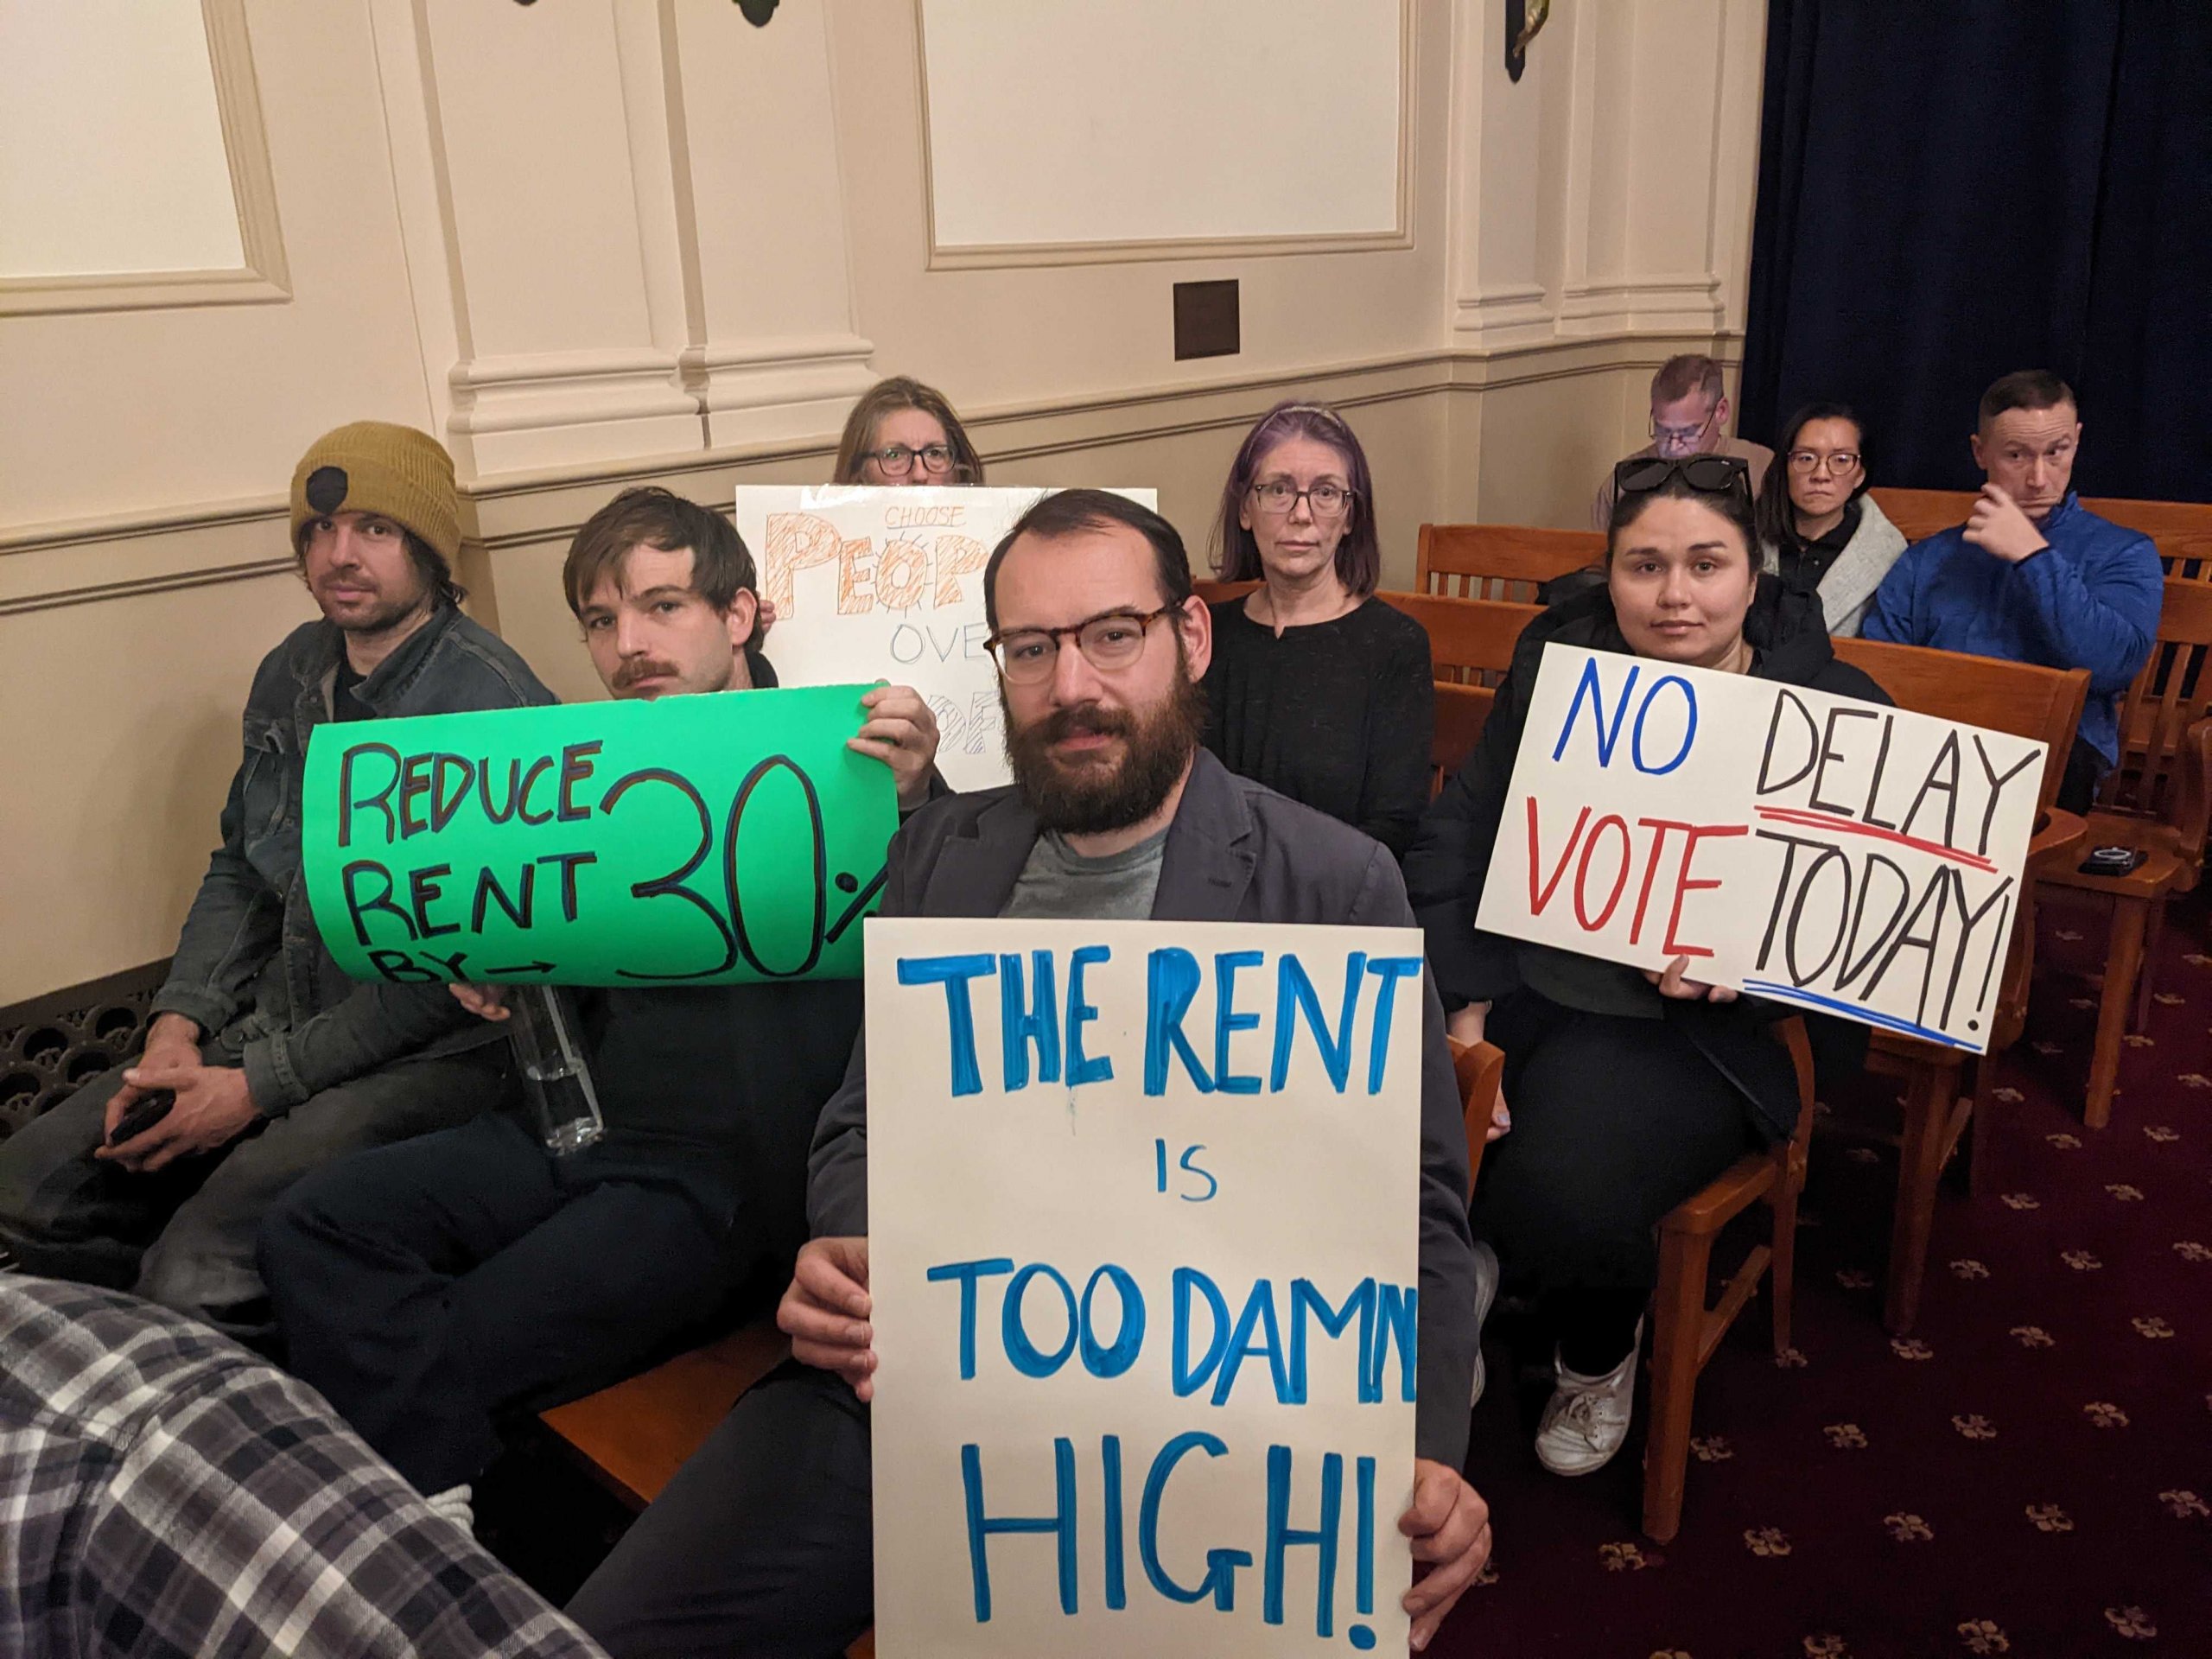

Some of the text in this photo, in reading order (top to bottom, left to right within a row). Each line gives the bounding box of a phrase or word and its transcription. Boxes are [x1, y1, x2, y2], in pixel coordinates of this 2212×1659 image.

[766, 512, 990, 620] PEOP
[884, 505, 967, 528] CHOOSE
[890, 622, 987, 664] OVE
[338, 740, 604, 848] REDUCE
[1552, 657, 2041, 855] NO DELAY
[342, 851, 597, 946] RENT
[1527, 796, 2014, 1031] VOTE TODAY!
[367, 950, 469, 982] BY
[897, 945, 1423, 1097] THE RENT
[1156, 1138, 1218, 1202] IS
[927, 1258, 1417, 1407] TOO DAMN
[961, 1431, 1377, 1650] HIGH!
